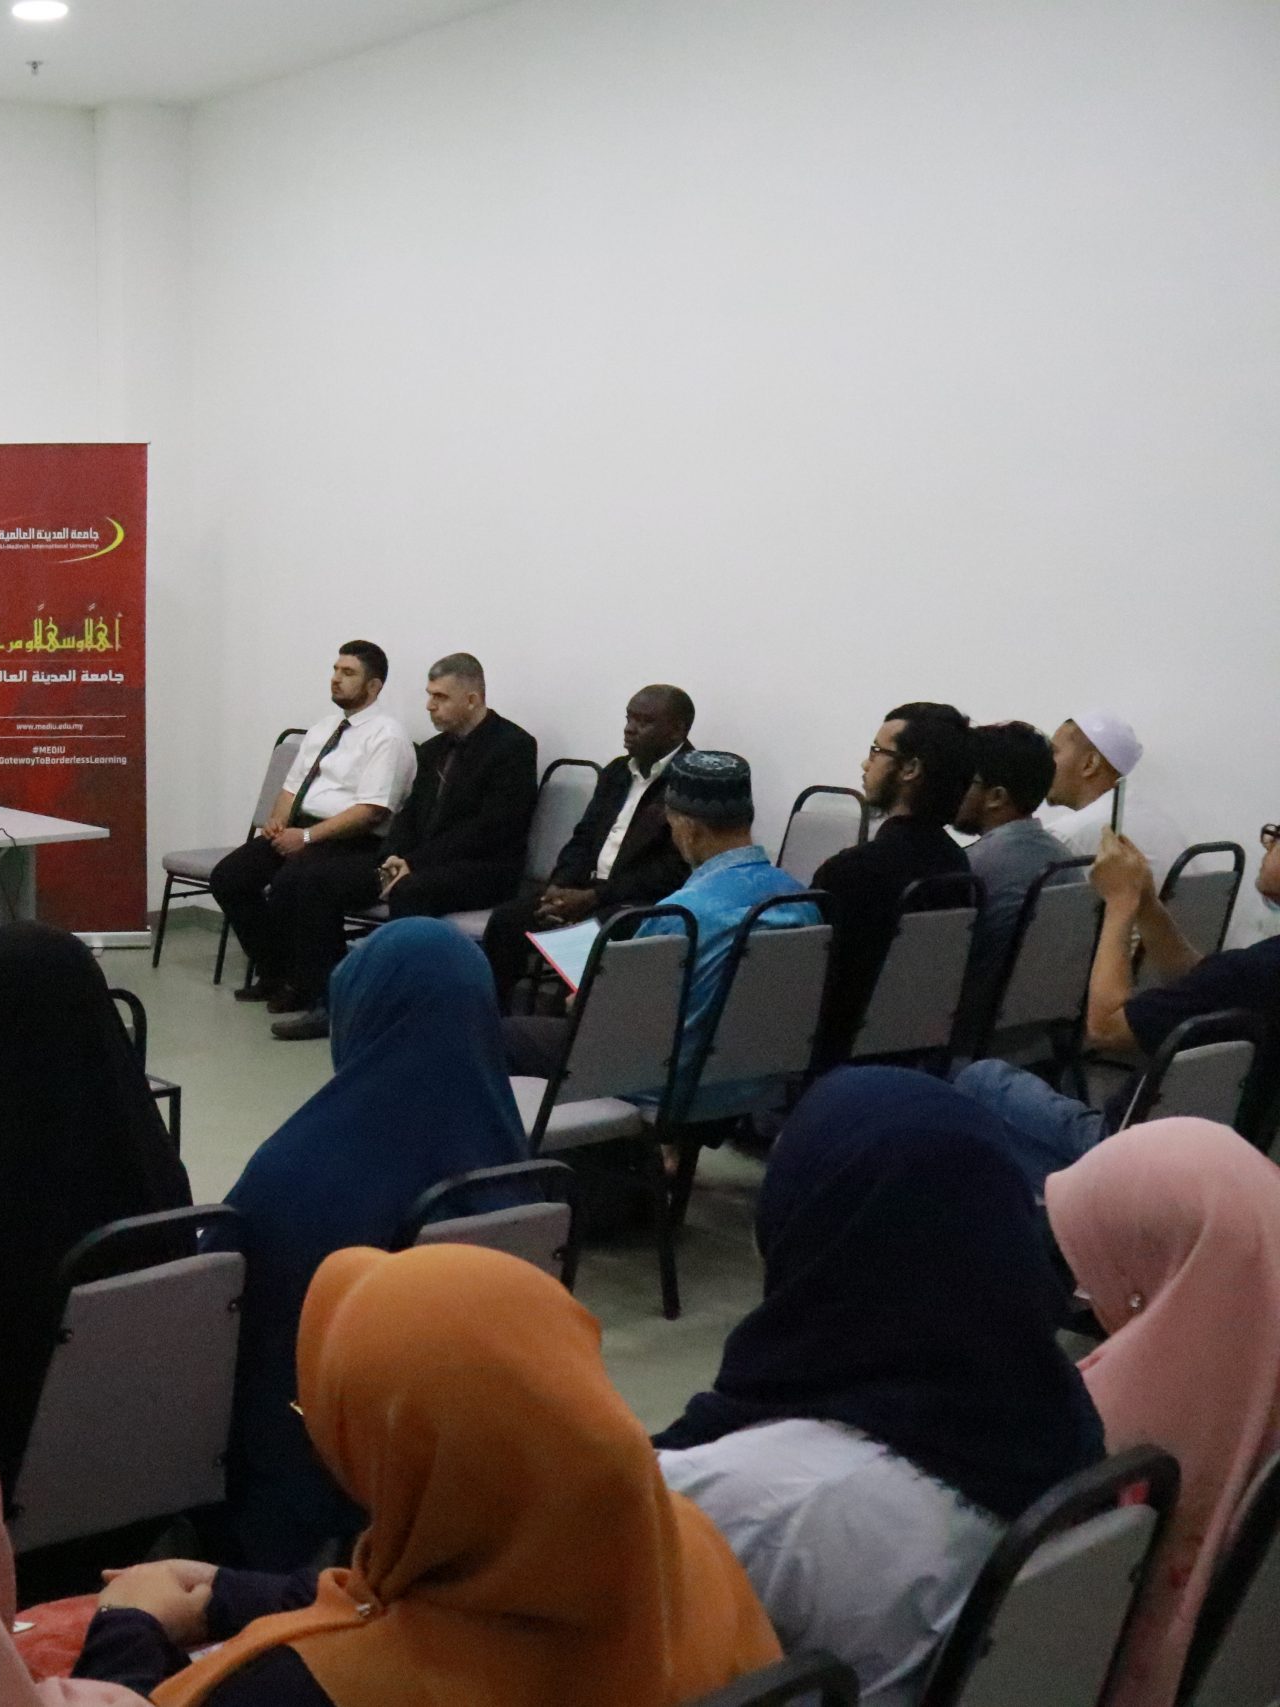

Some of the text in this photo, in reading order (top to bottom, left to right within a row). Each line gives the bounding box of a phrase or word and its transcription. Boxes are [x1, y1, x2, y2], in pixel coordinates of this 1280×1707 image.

[36, 527, 69, 542] المدينة
[70, 527, 100, 540] جامعة
[31, 669, 76, 685] المدينة
[80, 669, 125, 684] جامعة
[16, 722, 84, 731] www.mediu.edu.my
[32, 745, 66, 754] #MEDIU
